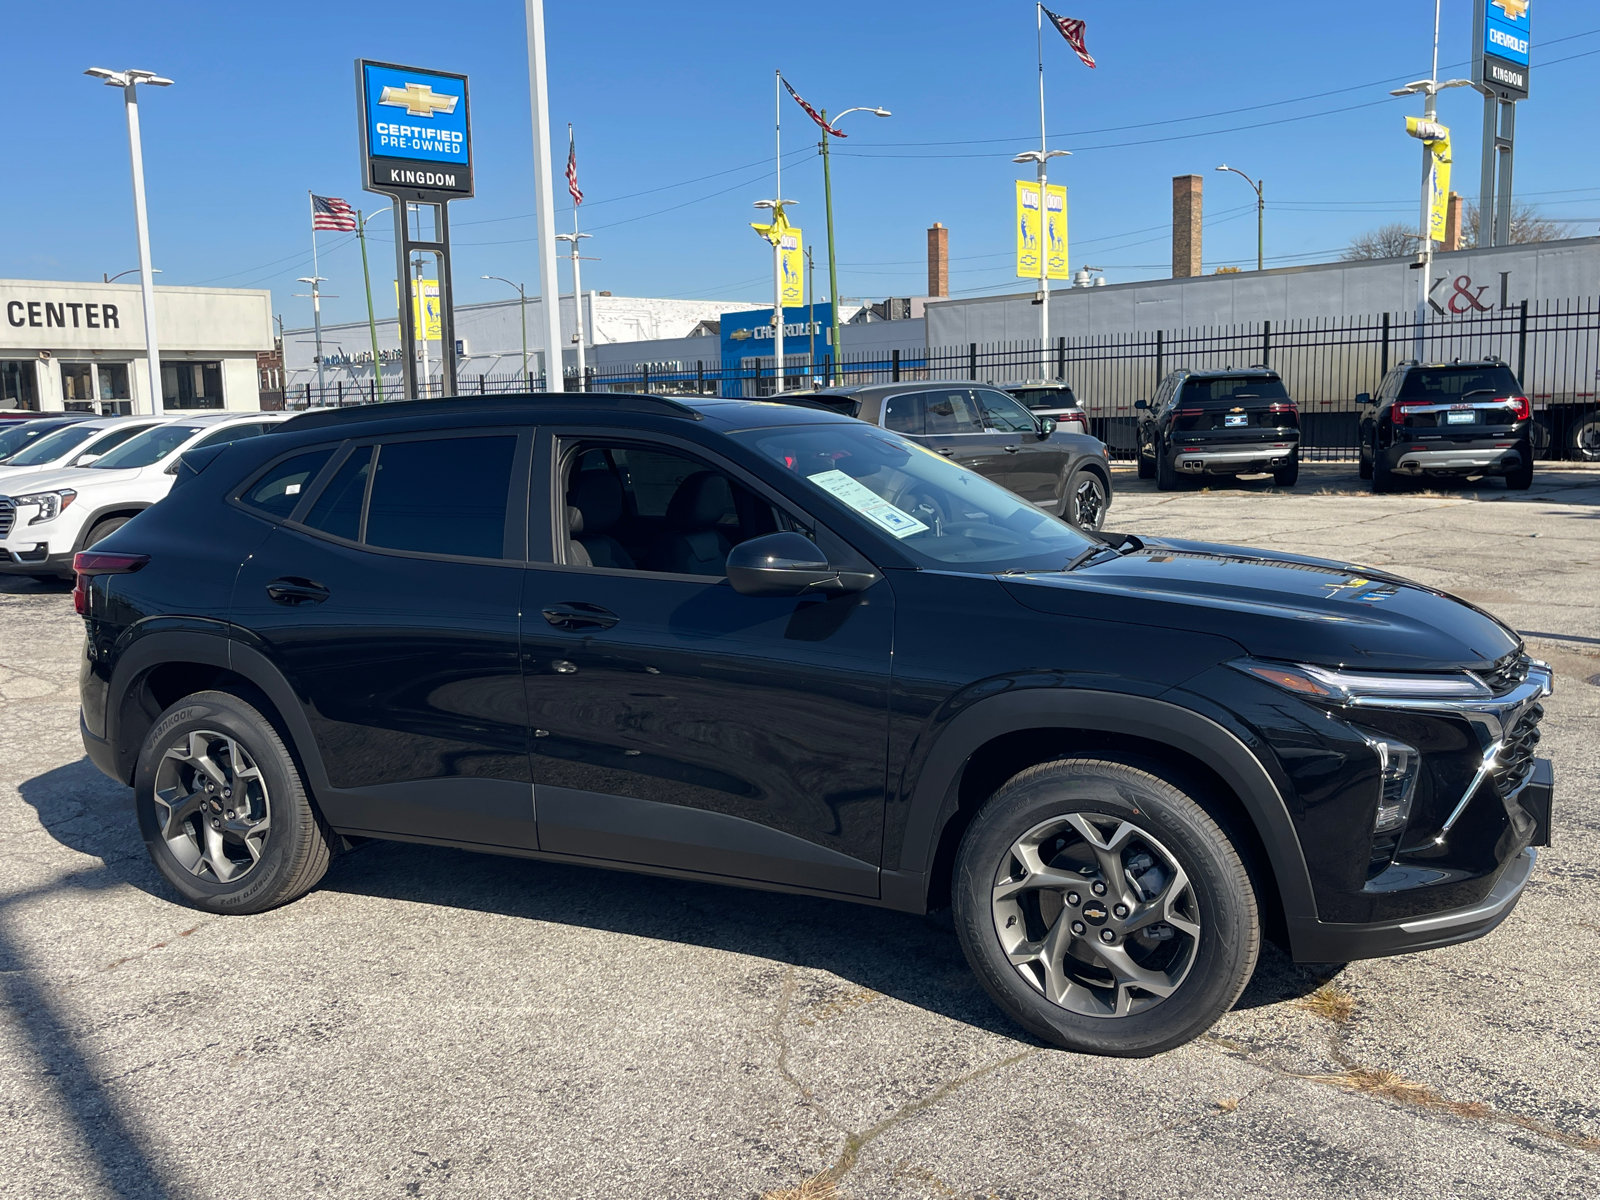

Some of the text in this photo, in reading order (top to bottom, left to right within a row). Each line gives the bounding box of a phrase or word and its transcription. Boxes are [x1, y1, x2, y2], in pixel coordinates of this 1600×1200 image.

[1489, 28, 1528, 54] CHEVROLET
[1492, 65, 1523, 87] KINGDOM
[376, 122, 463, 143] CERTIFIED
[381, 135, 460, 154] PRE-OWNED
[390, 168, 456, 187] KINGDOM
[1021, 187, 1039, 210] King
[1047, 191, 1063, 211] dom
[1448, 275, 1495, 314] &
[7, 300, 120, 329] CENTER
[753, 321, 822, 340] CHEROLET
